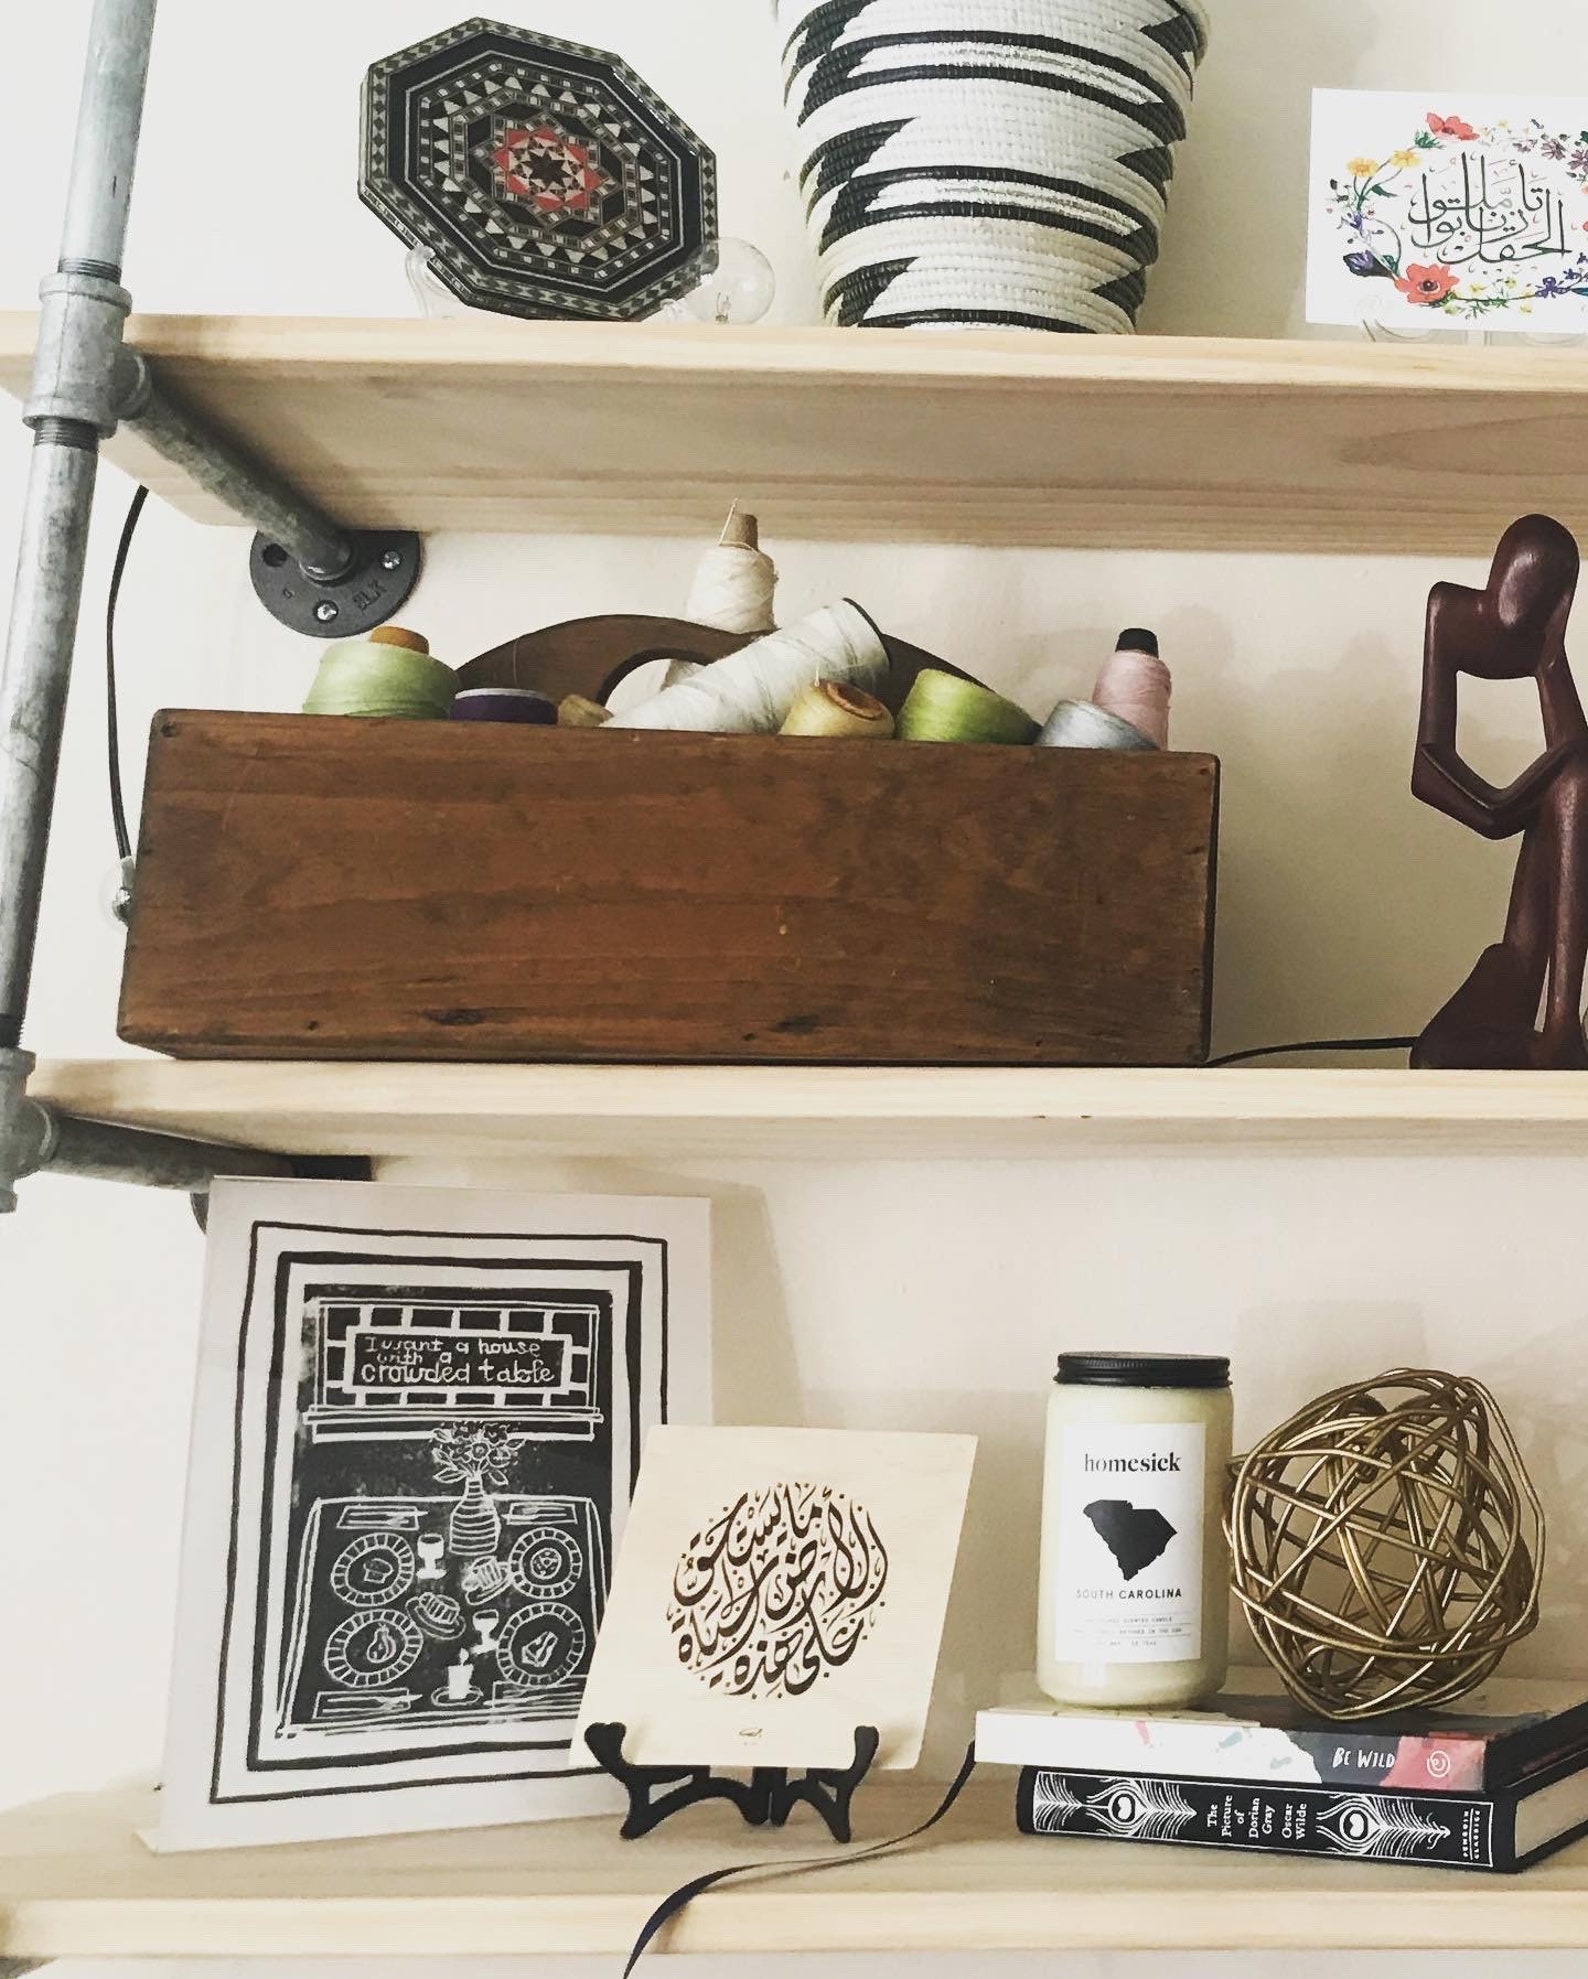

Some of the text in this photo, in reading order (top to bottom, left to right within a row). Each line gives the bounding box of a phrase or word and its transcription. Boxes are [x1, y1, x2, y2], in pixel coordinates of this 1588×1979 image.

[364, 1336, 541, 1356] I want a house
[376, 1351, 452, 1364] with a
[478, 1358, 556, 1383] table
[1084, 1451, 1182, 1473] homesick
[1076, 1588, 1182, 1600] SOUTH CAROLINA
[1331, 1747, 1395, 1768] BE WILD
[1206, 1803, 1219, 1828] The
[1221, 1794, 1233, 1838] Picture
[1234, 1808, 1245, 1825] of
[1248, 1797, 1261, 1839] Dorian
[1261, 1804, 1276, 1835] Gray
[1281, 1803, 1293, 1839] Oscar
[1295, 1803, 1308, 1840] Wilde
